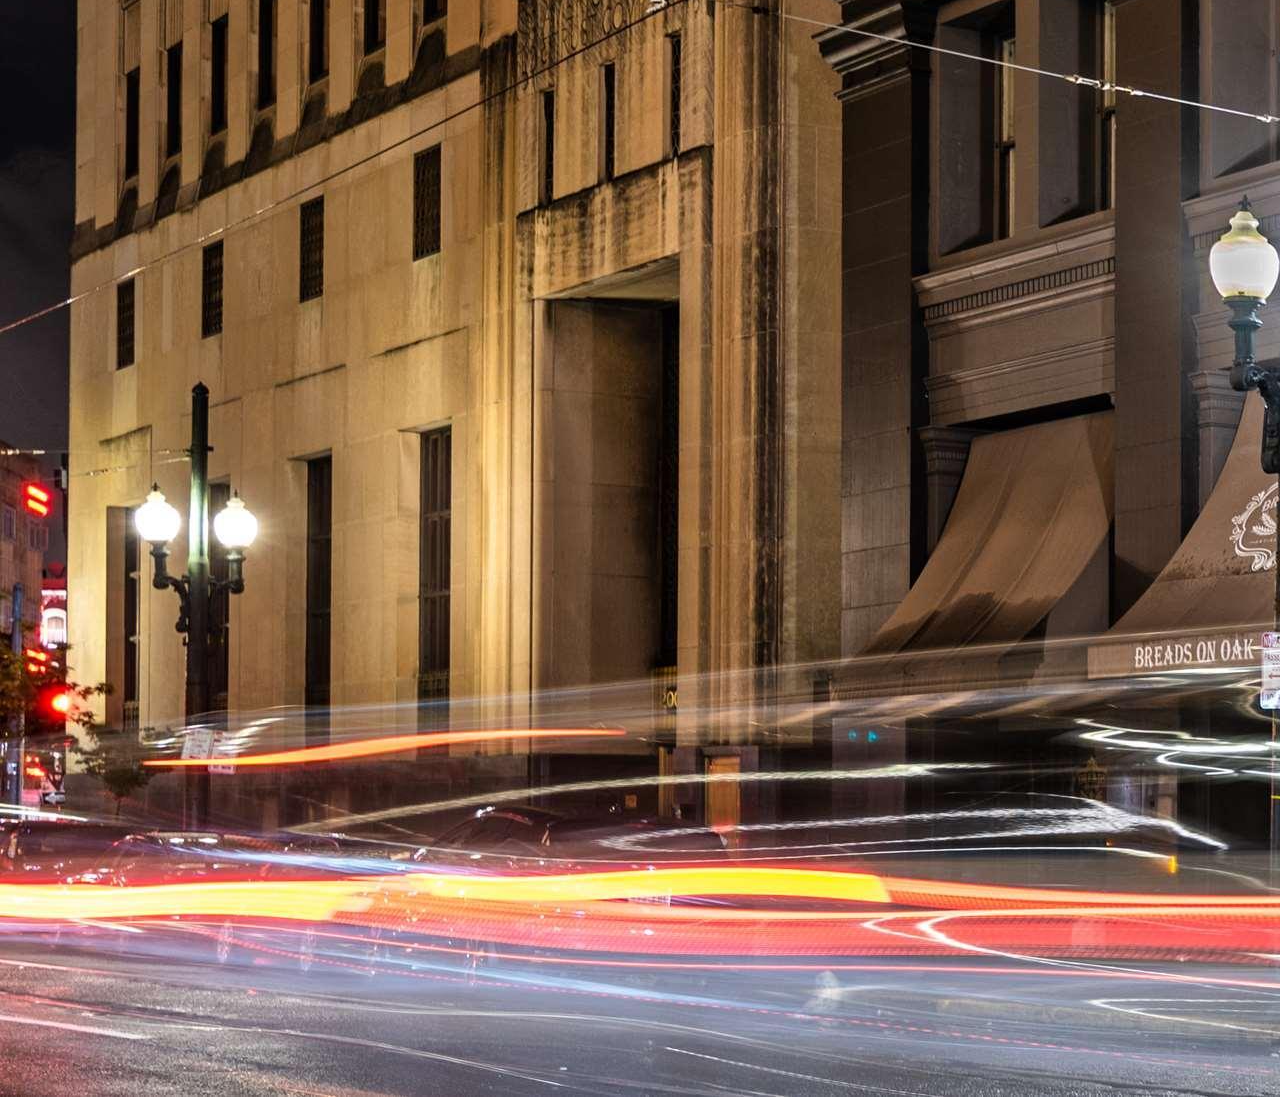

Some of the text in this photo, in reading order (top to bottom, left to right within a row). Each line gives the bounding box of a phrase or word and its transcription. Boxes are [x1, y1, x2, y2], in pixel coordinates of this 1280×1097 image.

[1134, 638, 1255, 669] BREADS ON OAK
